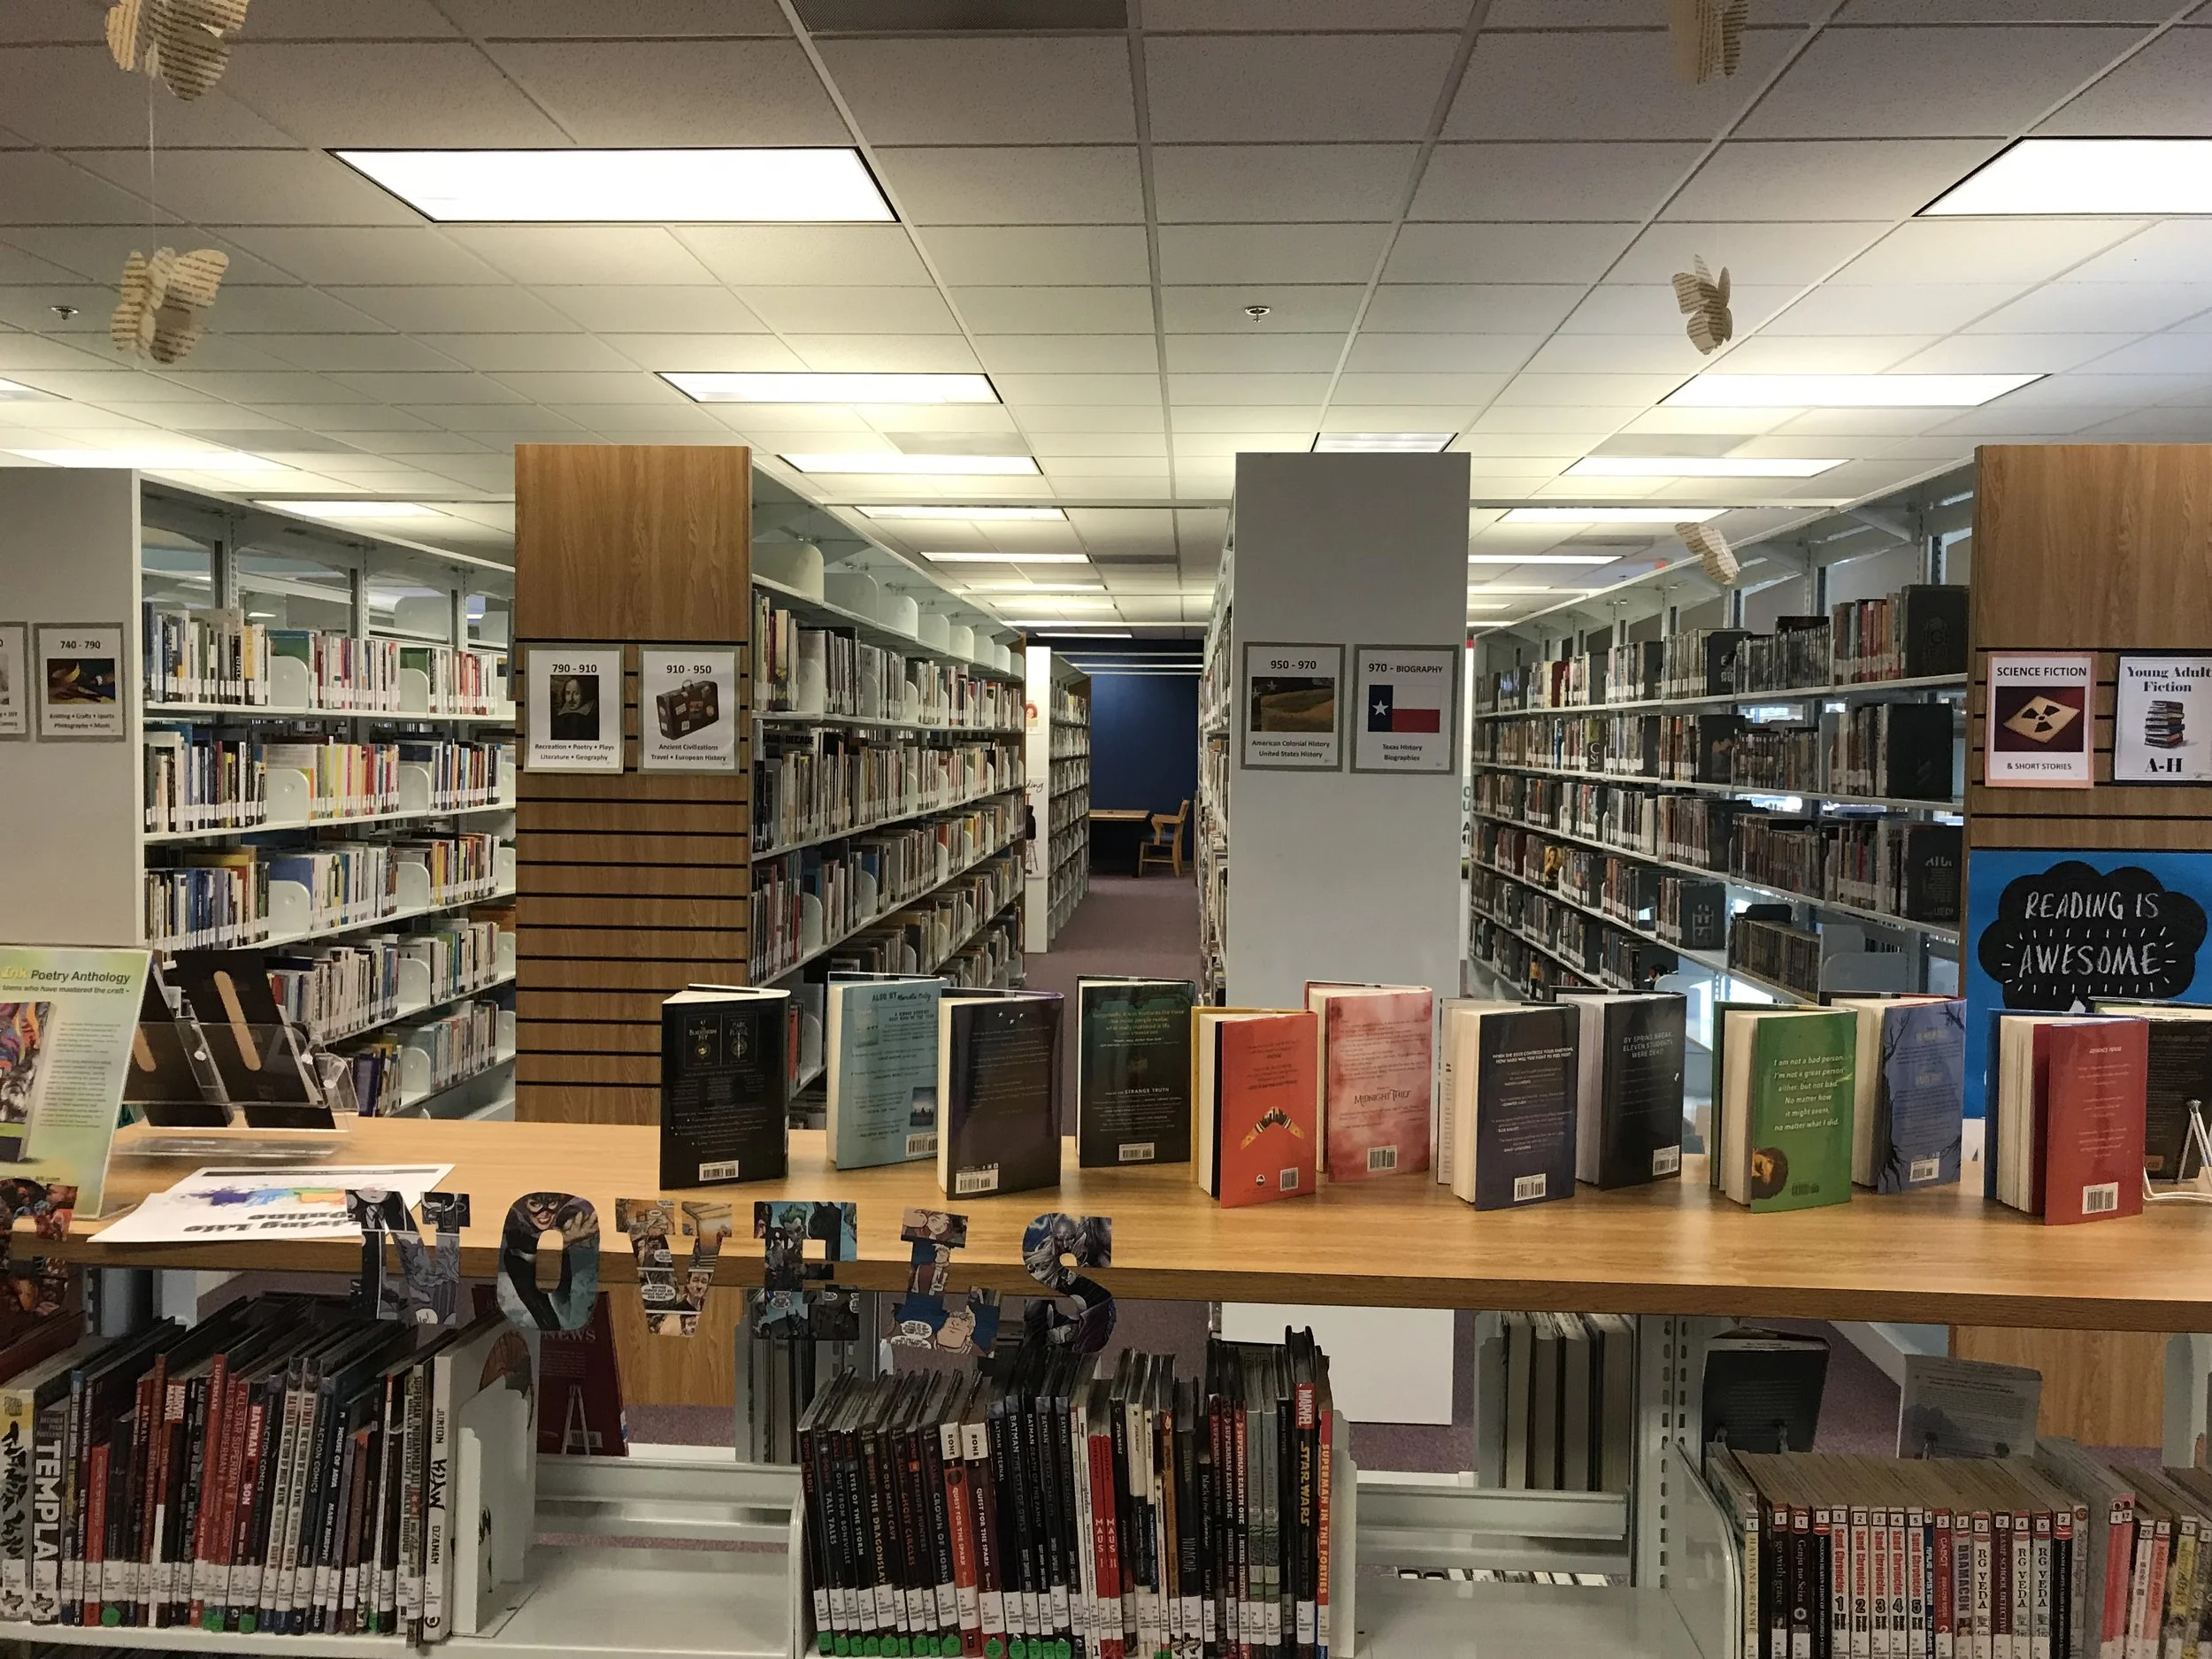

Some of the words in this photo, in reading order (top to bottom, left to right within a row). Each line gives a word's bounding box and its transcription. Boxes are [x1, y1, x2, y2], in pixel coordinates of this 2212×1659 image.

[60, 641, 76, 649] 740
[84, 641, 101, 649] 790
[552, 664, 571, 672] 790
[666, 664, 685, 673] 910
[693, 665, 712, 674] 950
[1271, 660, 1289, 670] 950
[1297, 660, 1317, 670] 970
[1368, 663, 1387, 672] 970
[1996, 666, 2041, 677] SCIENCE
[2044, 666, 2087, 677] FICTION
[2127, 666, 2169, 679] Young
[2172, 666, 2212, 678] Adult
[2143, 680, 2192, 692] Fiction
[2145, 757, 2183, 772] A-H
[2024, 891, 2123, 920] READING
[2136, 892, 2160, 918] IS
[2018, 941, 2162, 979] AWESOME
[31, 969, 69, 983] Poetry
[71, 971, 131, 985] Anthology
[1623, 1043, 1646, 1052] ELEVEN
[1647, 1039, 1672, 1049] STUDENTS
[1632, 1033, 1653, 1043] SPRING
[1648, 1048, 1663, 1056] DEAD
[1804, 1069, 1821, 1079] great
[1822, 1067, 1844, 1077] person
[1354, 1092, 1391, 1107] MIDNIGHT
[1389, 1088, 1412, 1102] THIEF
[1785, 1096, 1795, 1105] No
[1796, 1094, 1816, 1103] matter
[1792, 1107, 1810, 1118] might
[1806, 1119, 1822, 1128] what
[182, 1223, 253, 1233] Life
[211, 1363, 221, 1410] SUPERMAN
[237, 1390, 246, 1407] ALL
[412, 1376, 422, 1418] SUPERMAN
[1298, 1390, 1312, 1427] MARVEL
[234, 1410, 243, 1433] STAR
[247, 1405, 263, 1457] BATMAN
[435, 1409, 444, 1444] JURION
[1026, 1414, 1035, 1445] BATMAN
[260, 1425, 271, 1457] ACTION
[314, 1427, 325, 1459] ACTION
[334, 1426, 344, 1453] HOUSE
[1010, 1416, 1019, 1453] BATMAN
[218, 1423, 230, 1473] SUPERMAN
[147, 1450, 157, 1482] DELUXE
[227, 1436, 241, 1488] SUPERMAN
[996, 1452, 1005, 1482] ETERNAL
[1301, 1440, 1310, 1482] STAR
[1320, 1444, 1330, 1495] SUPERMAN
[257, 1459, 267, 1492] COMICS
[311, 1461, 321, 1494] COMICS
[330, 1469, 340, 1488] JAVA
[411, 1472, 420, 1484] ALI
[429, 1459, 447, 1510] KLAW
[34, 1439, 62, 1562] TEMPLA
[144, 1484, 153, 1519] EDITION
[242, 1483, 253, 1505] SON
[869, 1493, 879, 1515] THE
[1301, 1484, 1310, 1527] WARS
[326, 1503, 334, 1525] MARK
[825, 1492, 833, 1515] TALL
[829, 1518, 838, 1545] TALES
[1320, 1509, 1328, 1520] IN
[321, 1527, 333, 1561] MURPHY
[856, 1527, 864, 1556] STORM
[933, 1493, 943, 1530] CROWN
[939, 1549, 949, 1583] HORNS
[1094, 1518, 1104, 1553] MAUS
[1106, 1518, 1118, 1553] MAUS
[1319, 1526, 1328, 1546] THE
[1775, 1540, 1783, 1553] go
[1835, 1528, 1845, 1548] Sand
[1856, 1531, 1866, 1550] Sand
[1875, 1531, 1885, 1550] Sand
[1893, 1531, 1903, 1550] Sand
[1911, 1532, 1921, 1552] Sand
[1182, 1537, 1196, 1573] NIMONA
[1795, 1540, 1807, 1565] Genju
[1319, 1550, 1328, 1594] FORTIES
[1777, 1555, 1786, 1577] with
[1797, 1568, 1802, 1579] no
[1835, 1550, 1845, 1594] Chronicles
[1856, 1553, 1866, 1595] Chronicles
[1875, 1553, 1885, 1596] Chronicles
[1893, 1553, 1903, 1595] Chronicles
[1912, 1555, 1922, 1597] Chronicles
[1958, 1545, 1970, 1611] DRAMACON
[1774, 1579, 1783, 1605] grace
[1797, 1581, 1807, 1602] Seiza
[1978, 1572, 1987, 1609] VEDA
[2017, 1571, 2027, 1608] VEDA
[2038, 1571, 2047, 1607] VEDA
[1855, 1599, 1865, 1613] 2
[1876, 1599, 1886, 1613] 3
[1893, 1598, 1903, 1613] 4
[1911, 1600, 1922, 1614] 5
